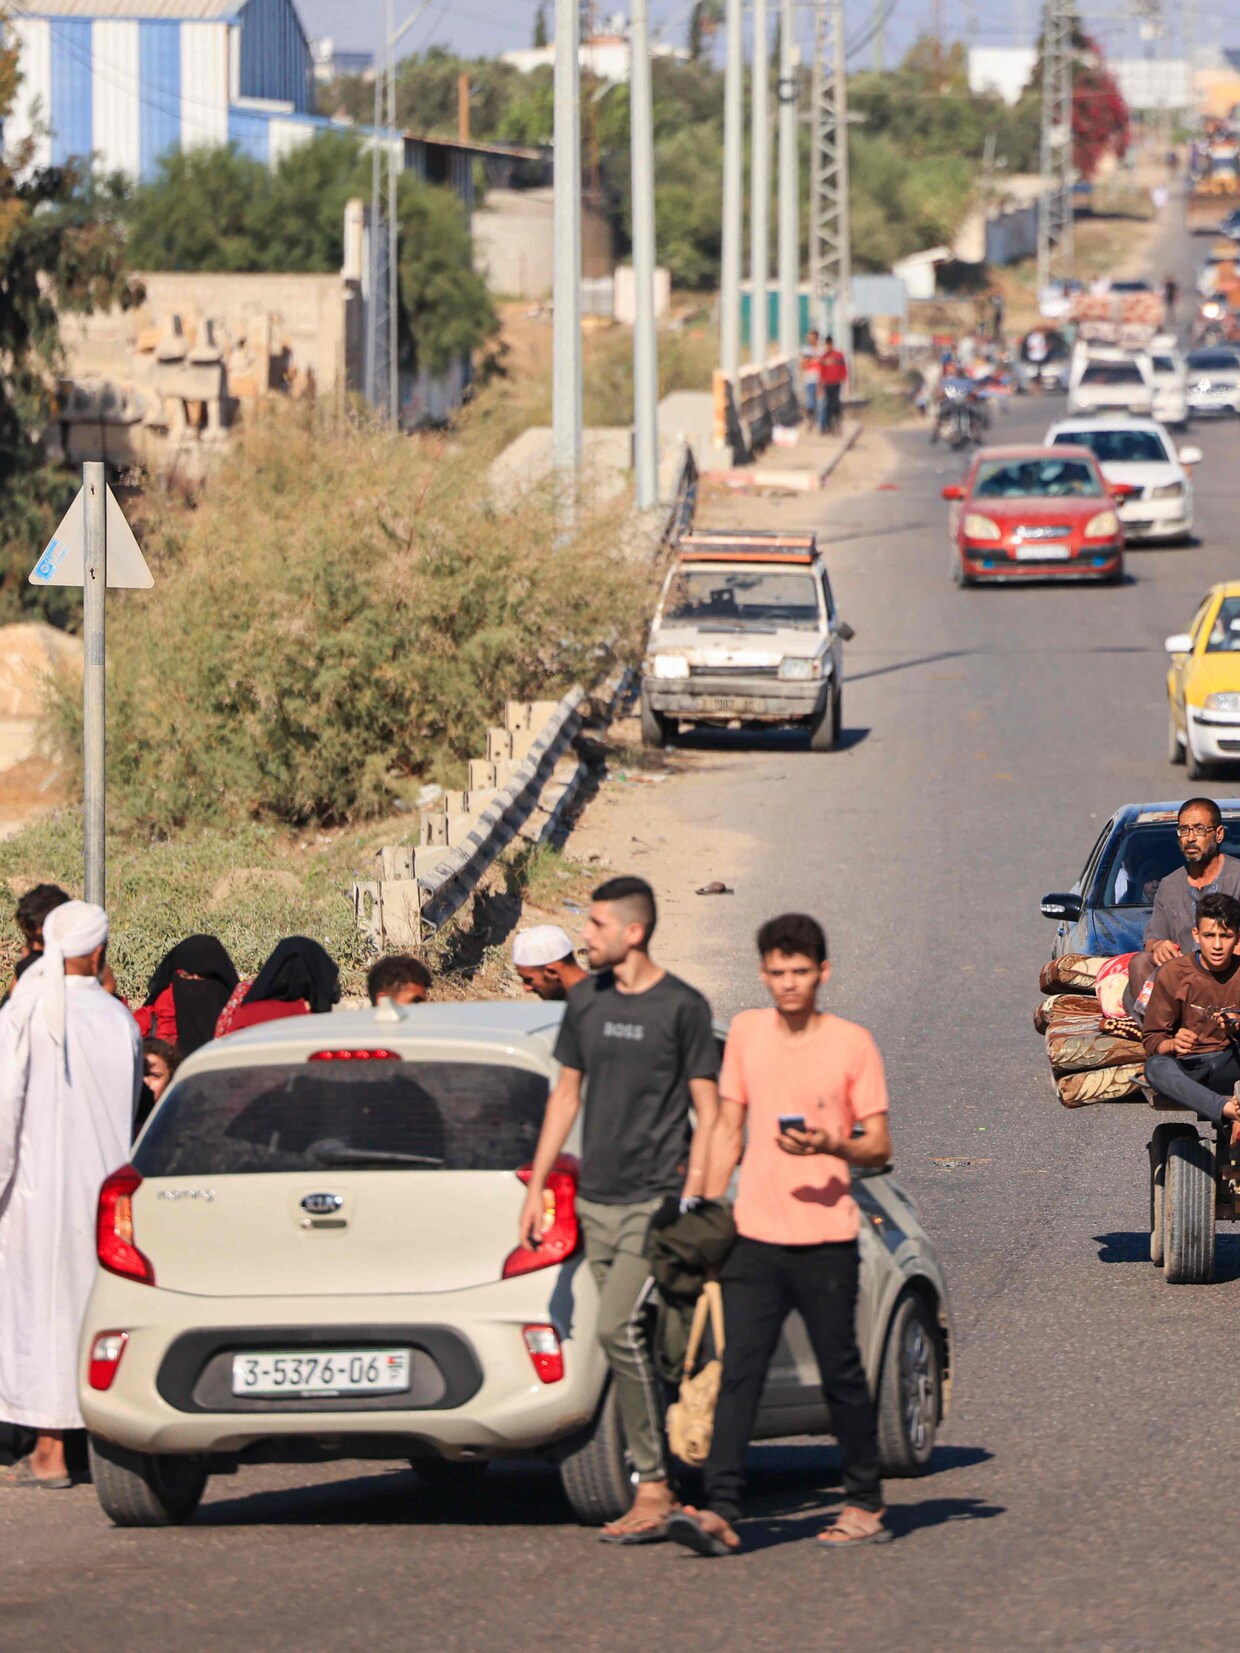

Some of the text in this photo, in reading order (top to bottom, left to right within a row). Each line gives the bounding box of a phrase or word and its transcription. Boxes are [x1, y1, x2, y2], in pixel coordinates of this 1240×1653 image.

[603, 1021, 645, 1040] BOSS
[307, 1195, 337, 1210] KIA
[245, 1357, 379, 1386] 3-5376-06
